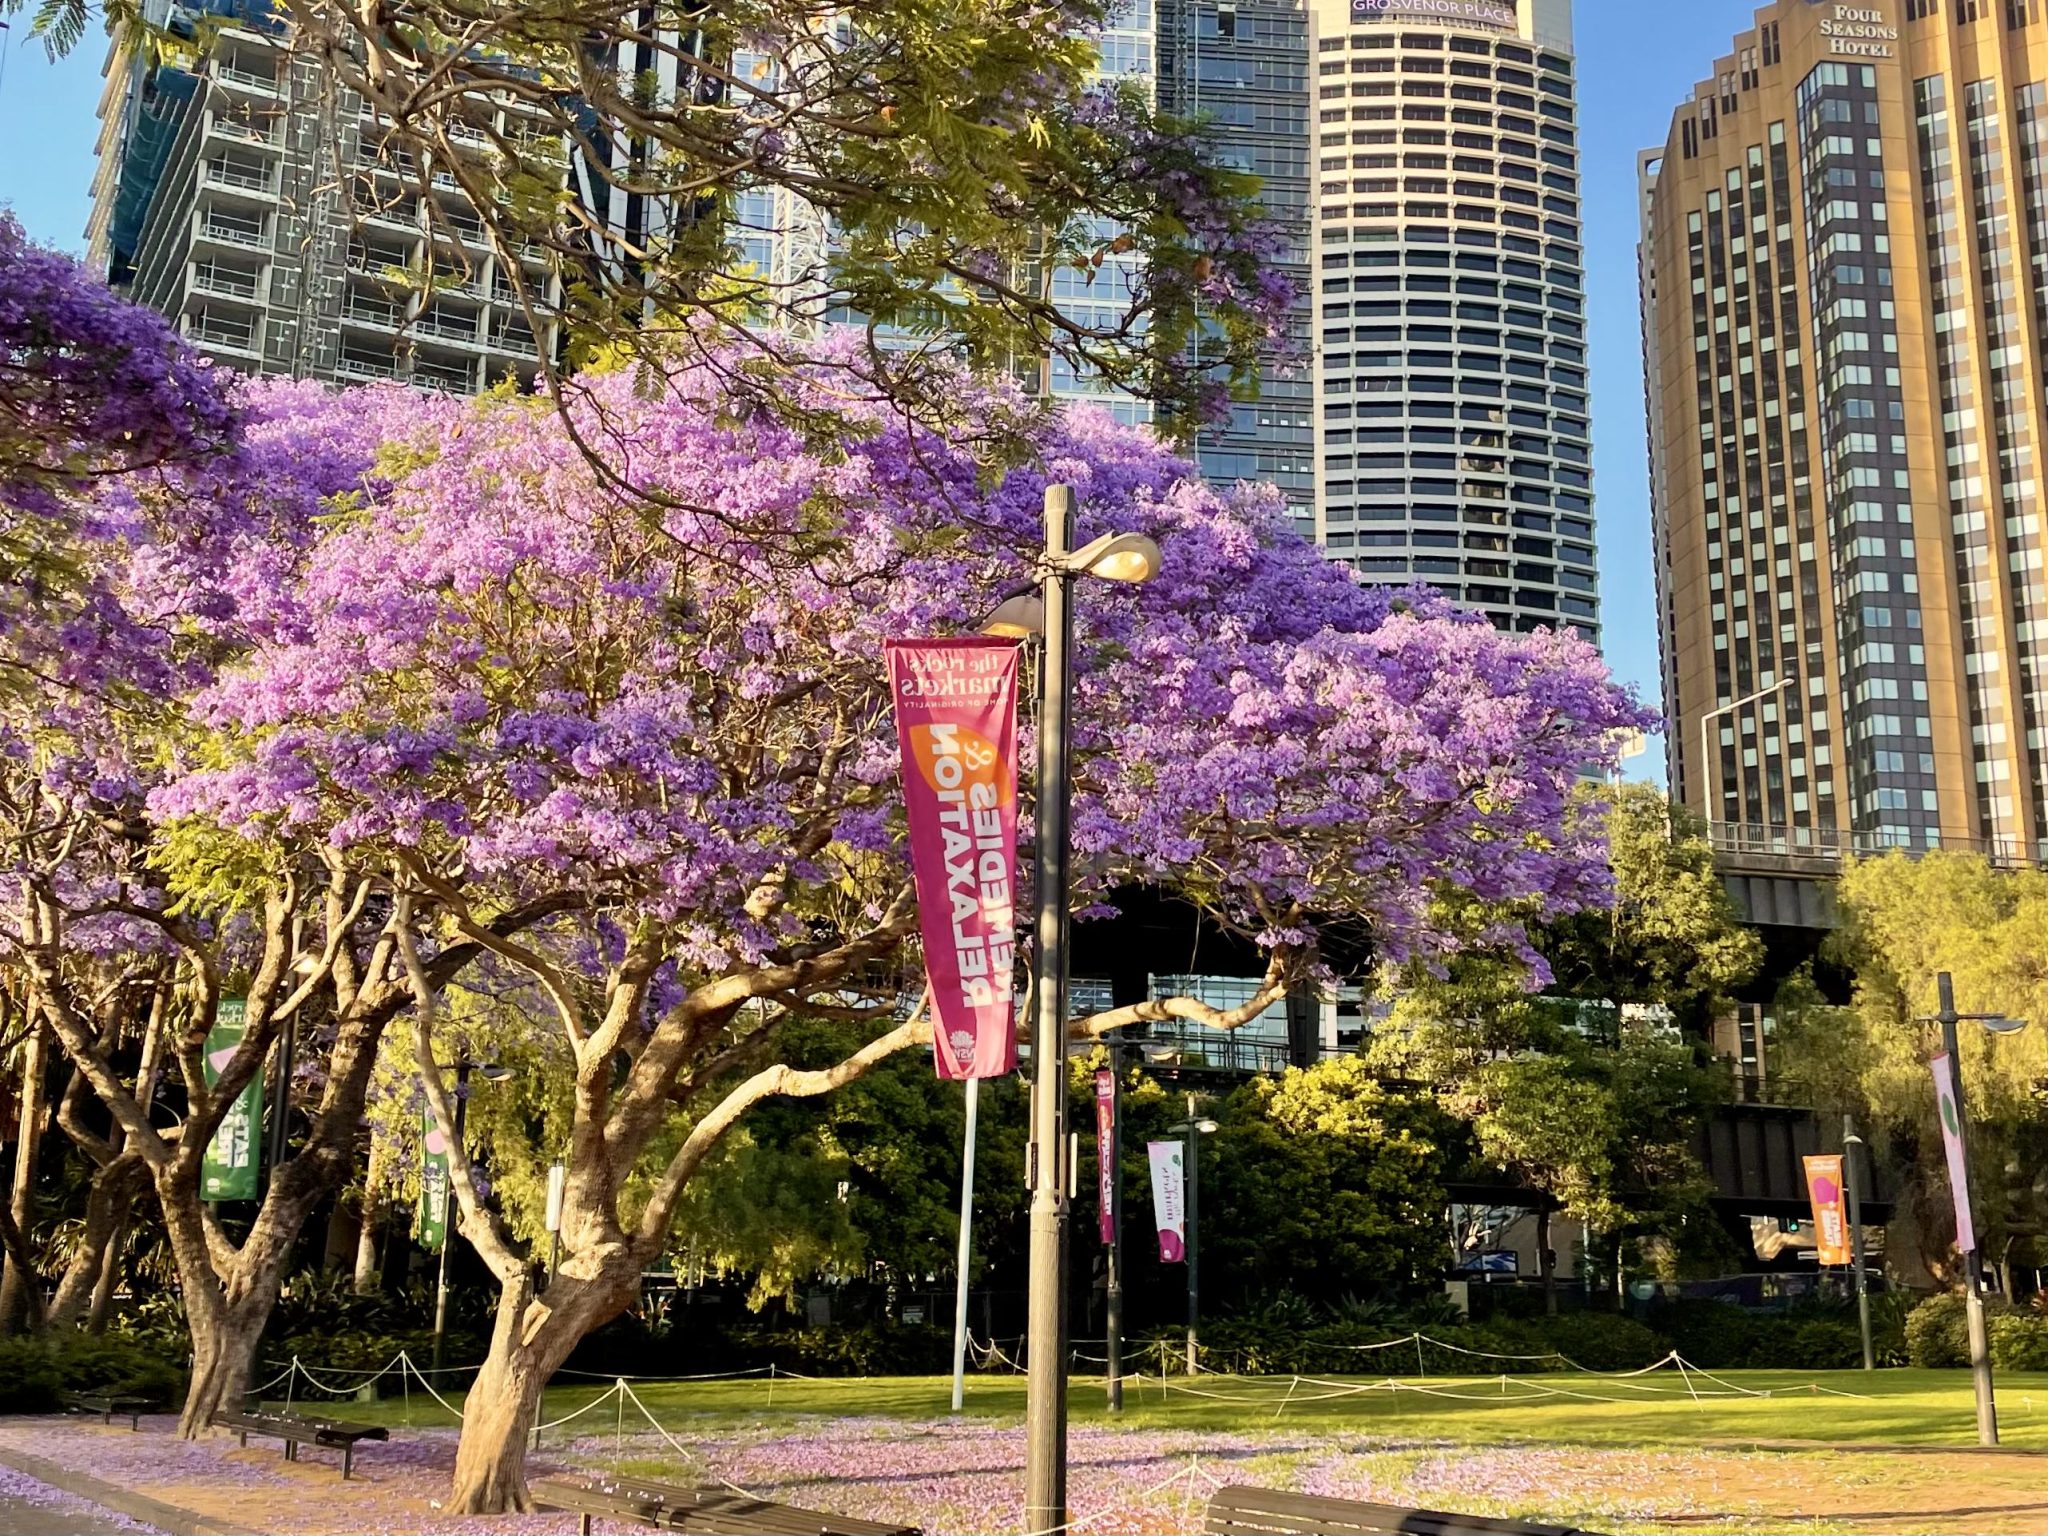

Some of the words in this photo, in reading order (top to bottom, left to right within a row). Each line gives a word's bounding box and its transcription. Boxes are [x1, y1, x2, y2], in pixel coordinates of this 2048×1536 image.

[1352, 0, 1461, 14] GROSVENOR
[1464, 3, 1512, 24] PLACE
[1834, 4, 1883, 23] FOUR
[1820, 19, 1898, 40] SEASONS
[1829, 38, 1893, 58] HOTEL
